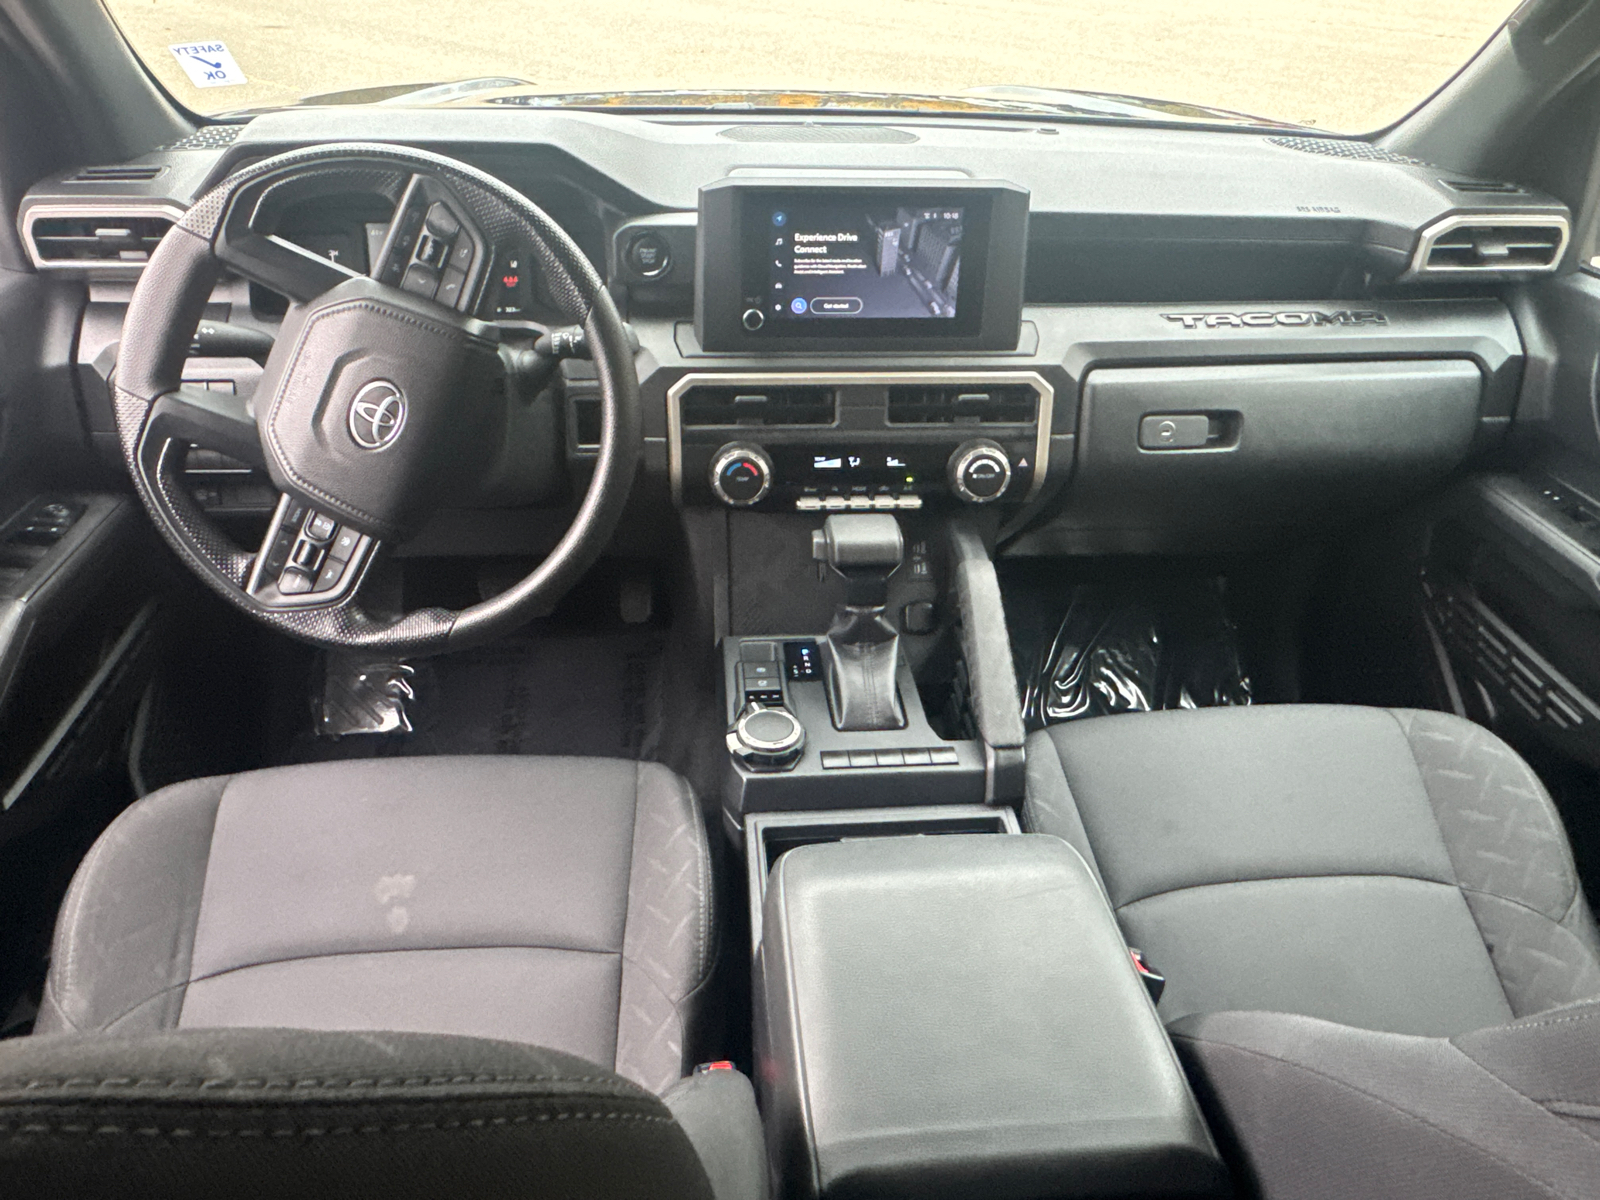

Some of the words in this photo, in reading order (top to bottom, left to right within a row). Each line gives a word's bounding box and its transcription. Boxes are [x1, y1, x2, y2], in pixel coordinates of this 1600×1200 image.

[794, 233, 837, 243] Experience
[837, 233, 858, 242] Drive
[794, 245, 827, 254] Connect
[1160, 310, 1388, 328] TACOMA
